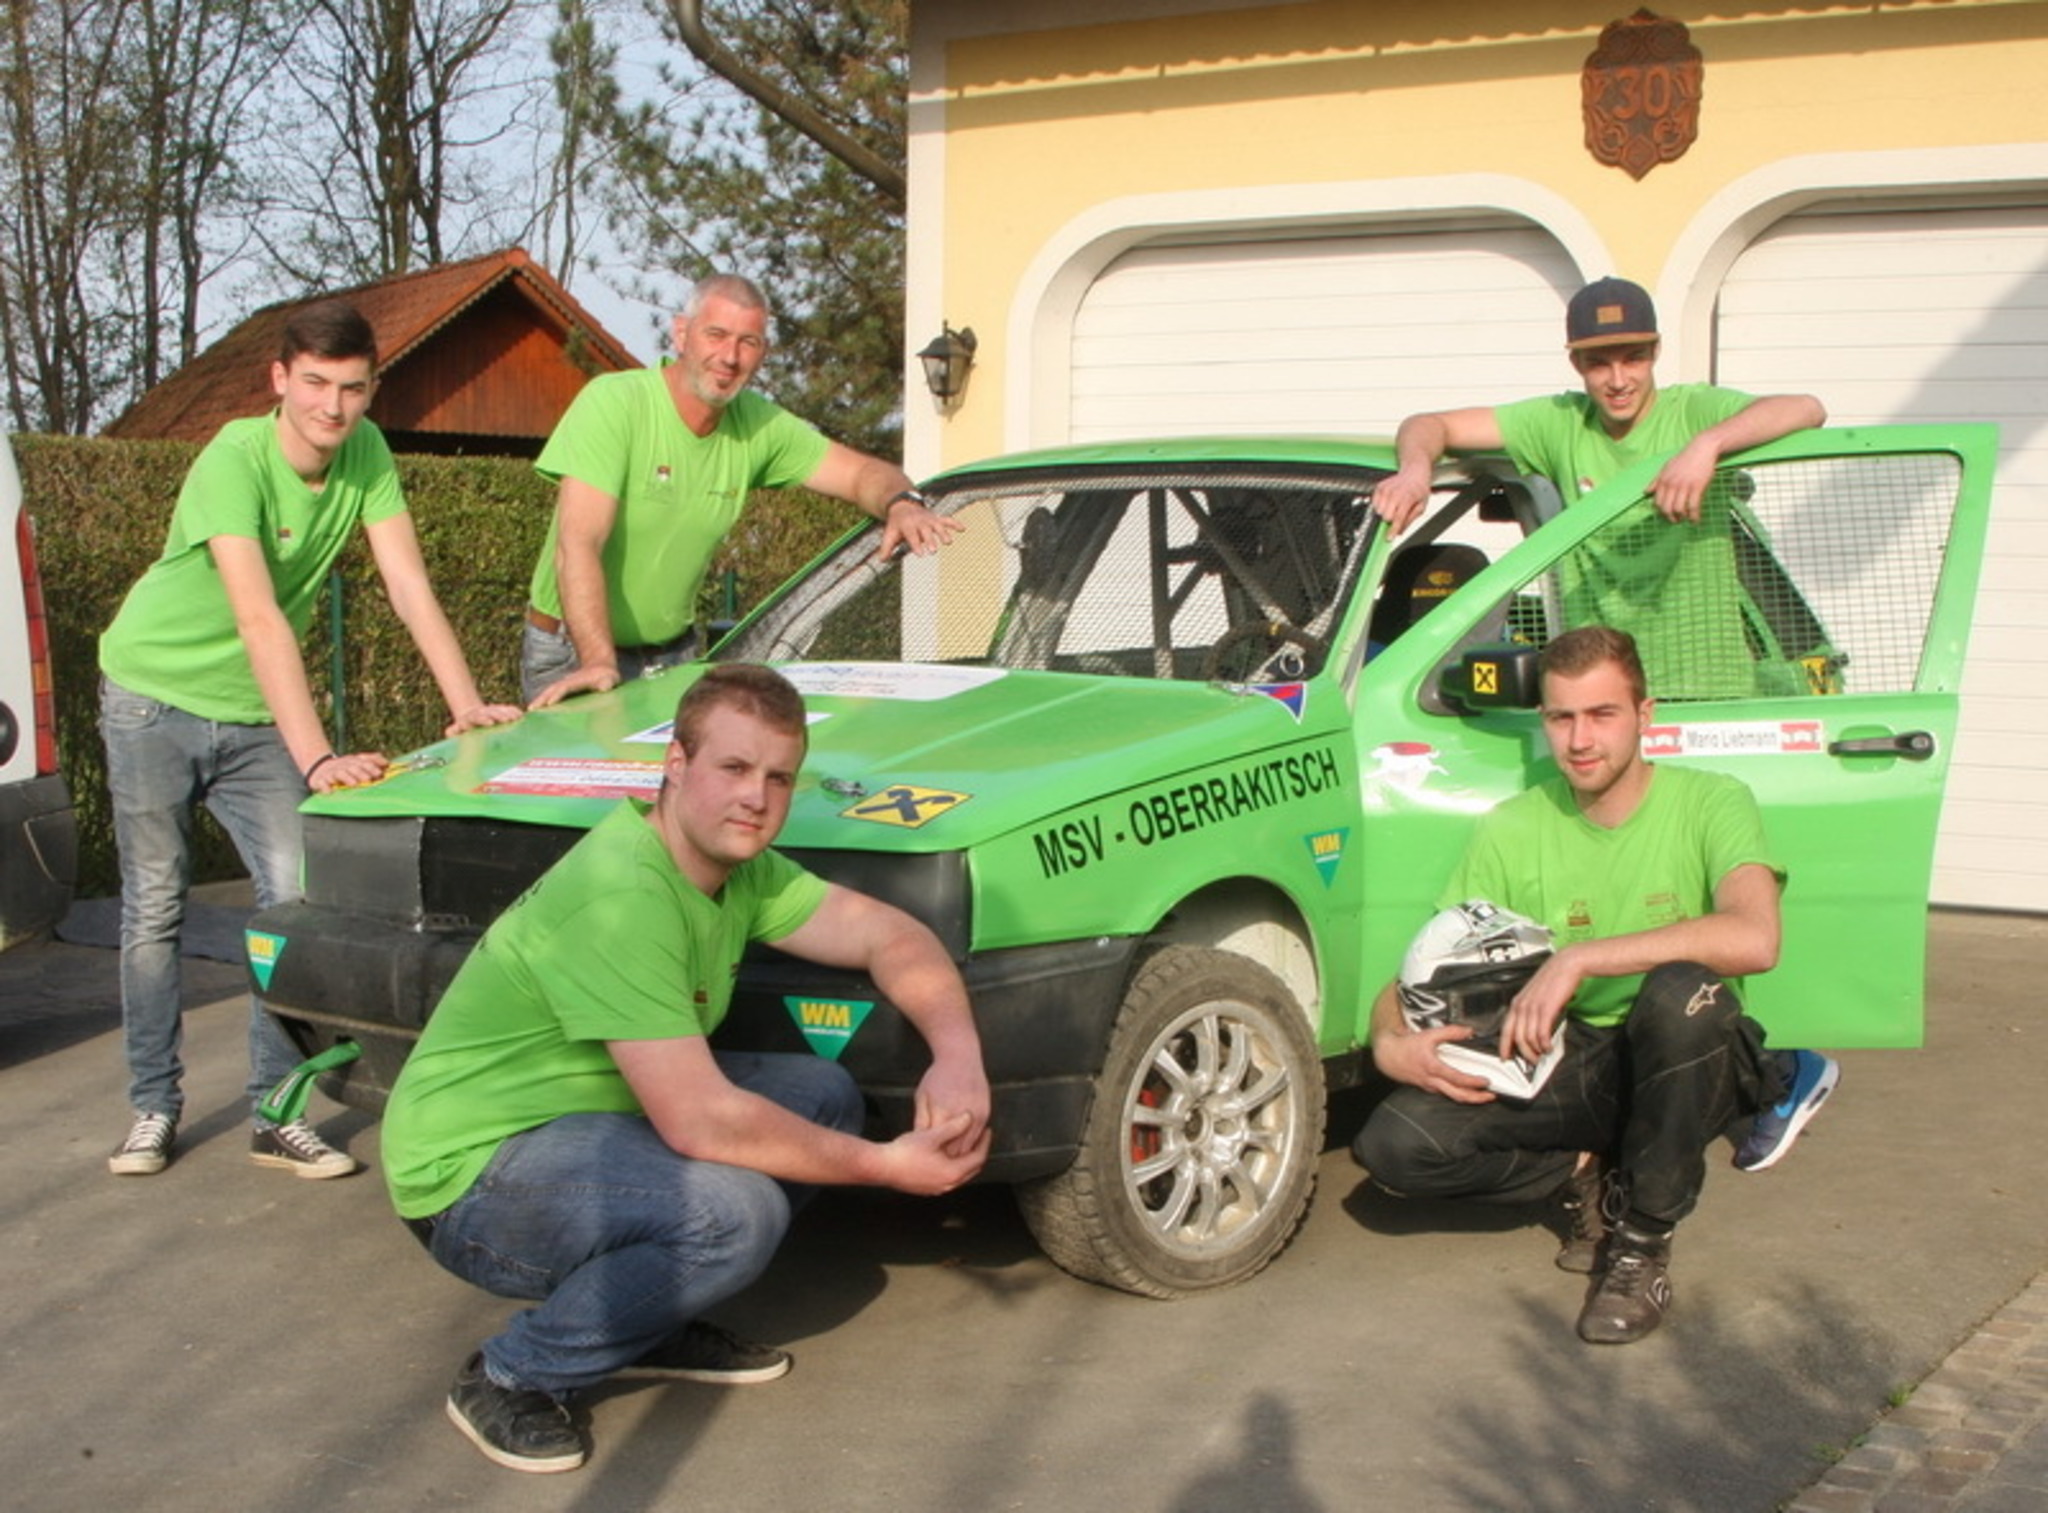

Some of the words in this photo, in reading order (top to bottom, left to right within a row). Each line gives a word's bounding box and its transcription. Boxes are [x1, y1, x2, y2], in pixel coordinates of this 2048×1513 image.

[1612, 66, 1671, 120] 30
[1033, 816, 1104, 879] MSV
[1128, 747, 1341, 847] OBERRAKITSCH
[800, 1002, 851, 1028] WM
